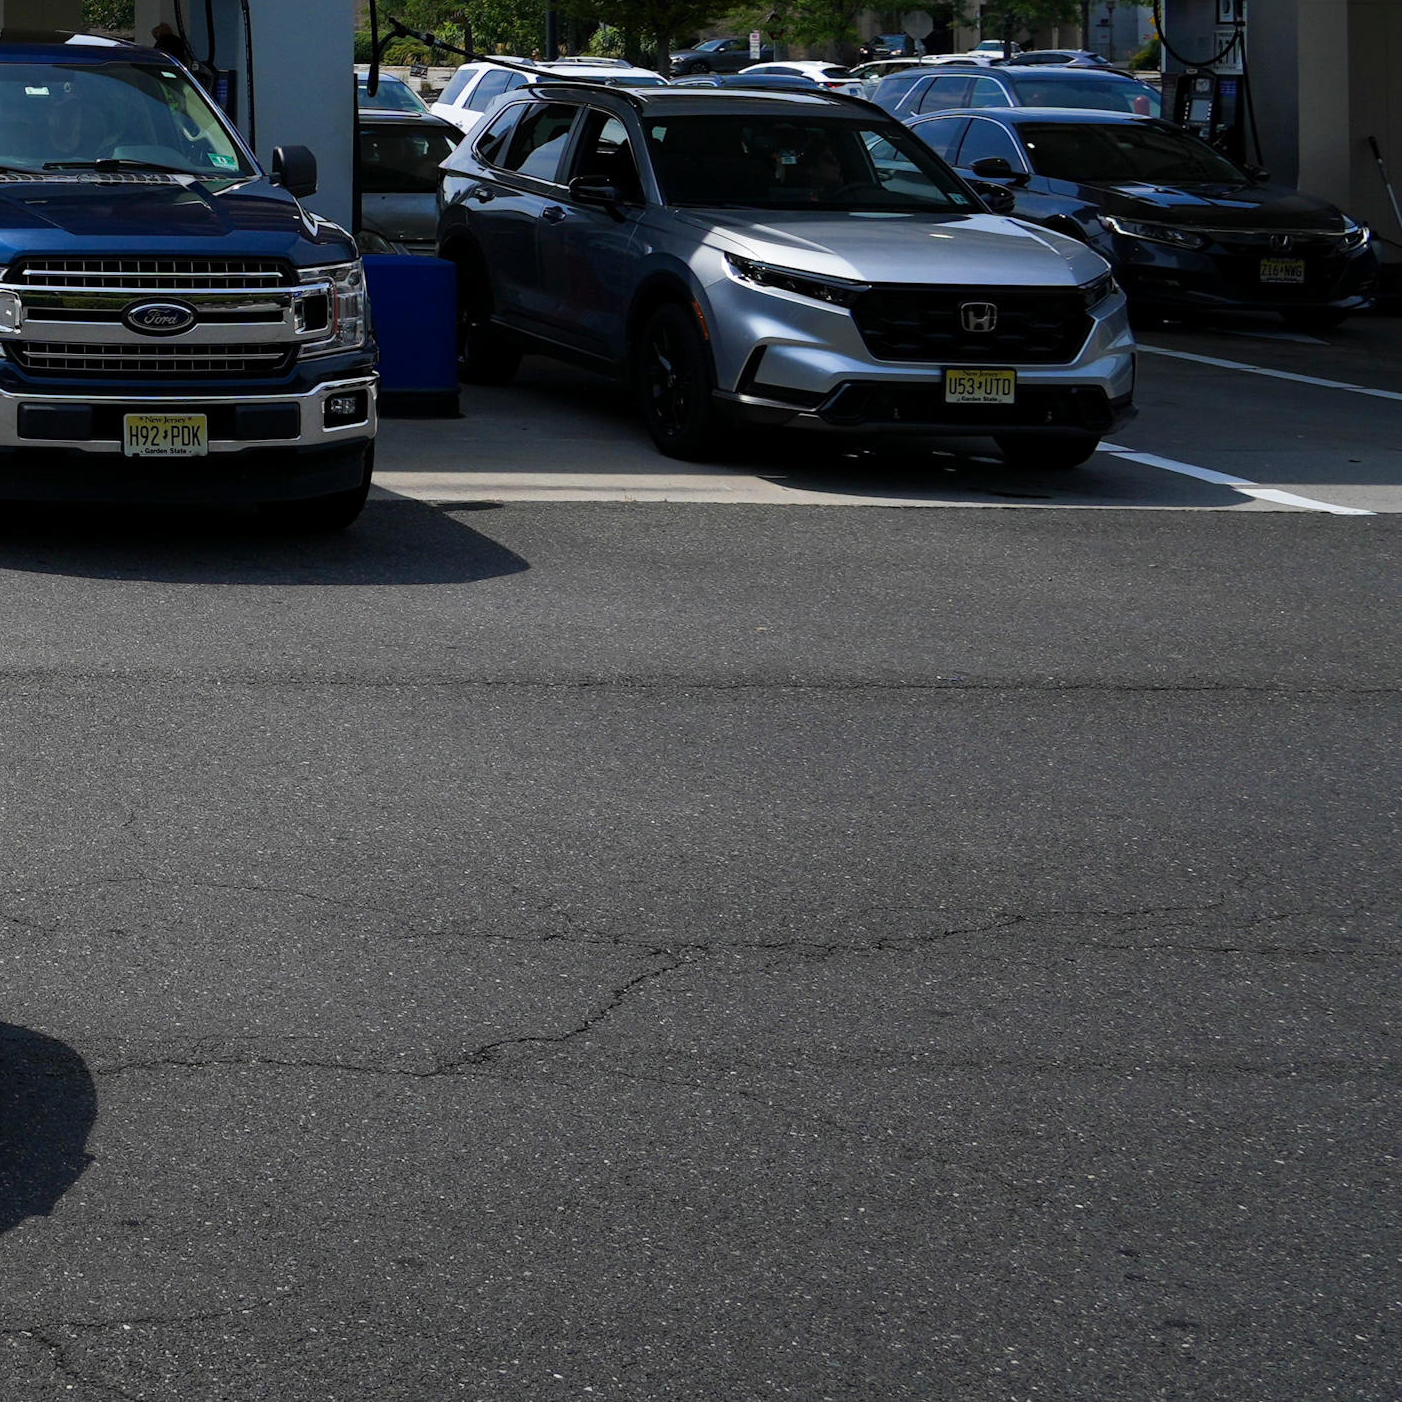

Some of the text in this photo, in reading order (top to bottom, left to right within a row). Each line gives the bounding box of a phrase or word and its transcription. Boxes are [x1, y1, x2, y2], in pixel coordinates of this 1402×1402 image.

[144, 308, 179, 325] Ford
[949, 377, 1011, 396] U53 UTD
[164, 416, 186, 425] Jersey
[129, 425, 202, 446] H92 PDK
